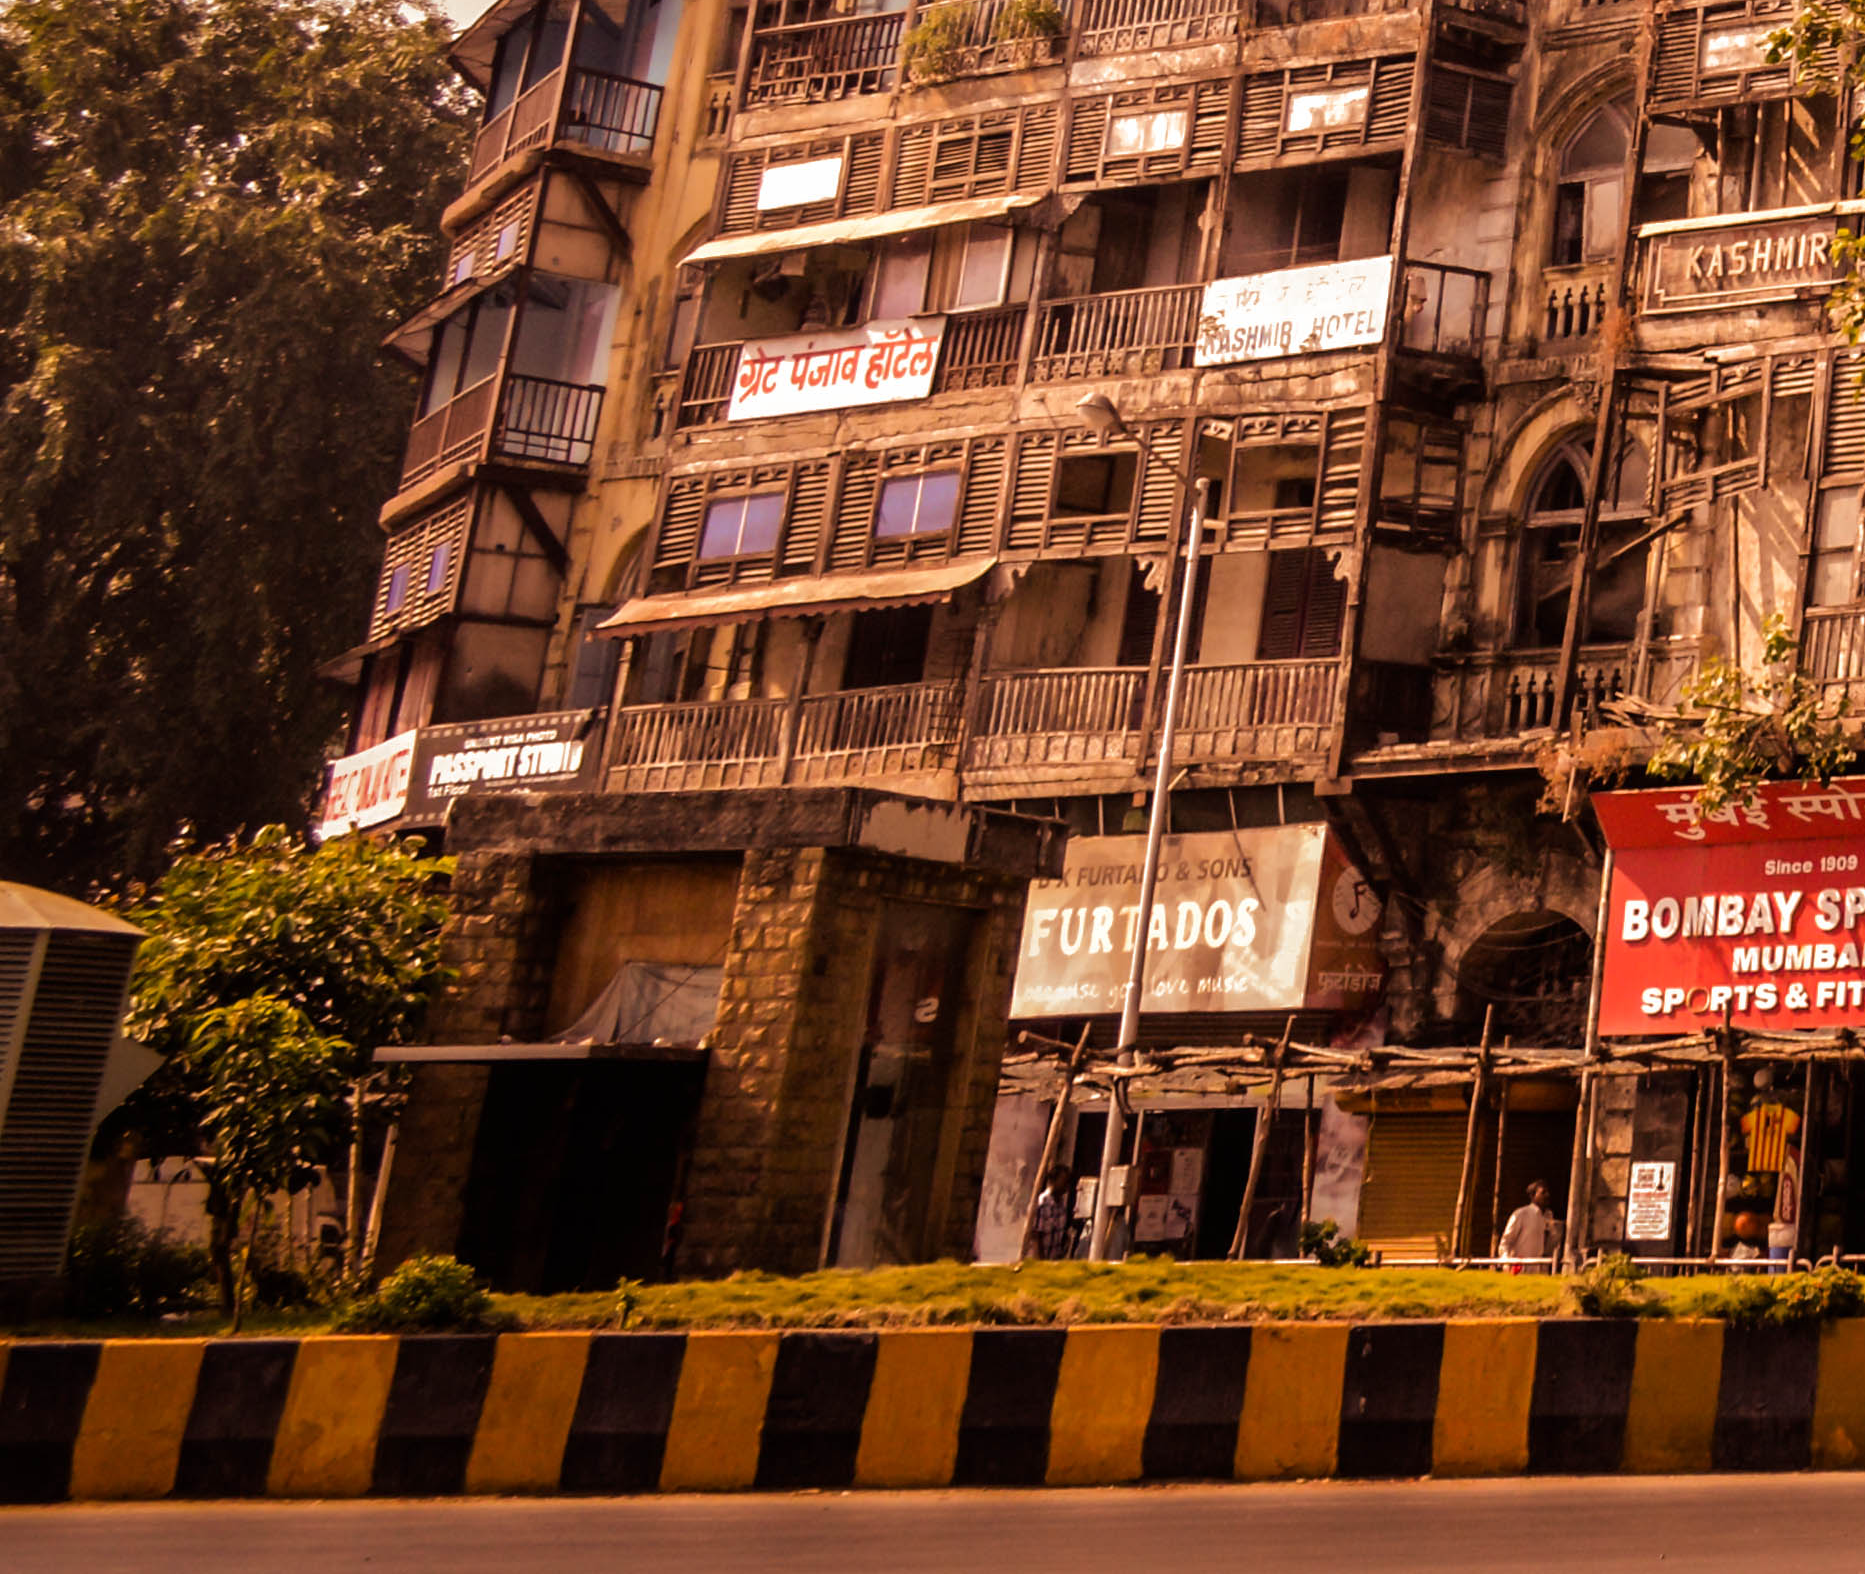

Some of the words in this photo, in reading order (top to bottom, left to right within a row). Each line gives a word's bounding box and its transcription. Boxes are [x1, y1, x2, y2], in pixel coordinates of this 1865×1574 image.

[1686, 232, 1832, 278] KASHMIR
[1312, 309, 1377, 343] HOTEL
[739, 346, 786, 402] ग्रेट
[865, 328, 939, 389] हॉटेल
[428, 746, 519, 785] PASSPORT
[517, 740, 584, 776] STUDIO
[1076, 863, 1168, 887] FURTAO
[1197, 857, 1254, 881] SONS
[1765, 858, 1813, 876] Since
[1820, 855, 1859, 873] 1909
[1027, 897, 1260, 958] FURTADOS
[1621, 890, 1804, 942] BOMBAY
[1641, 983, 1778, 1016] SPORTS
[1785, 982, 1809, 1009] &
